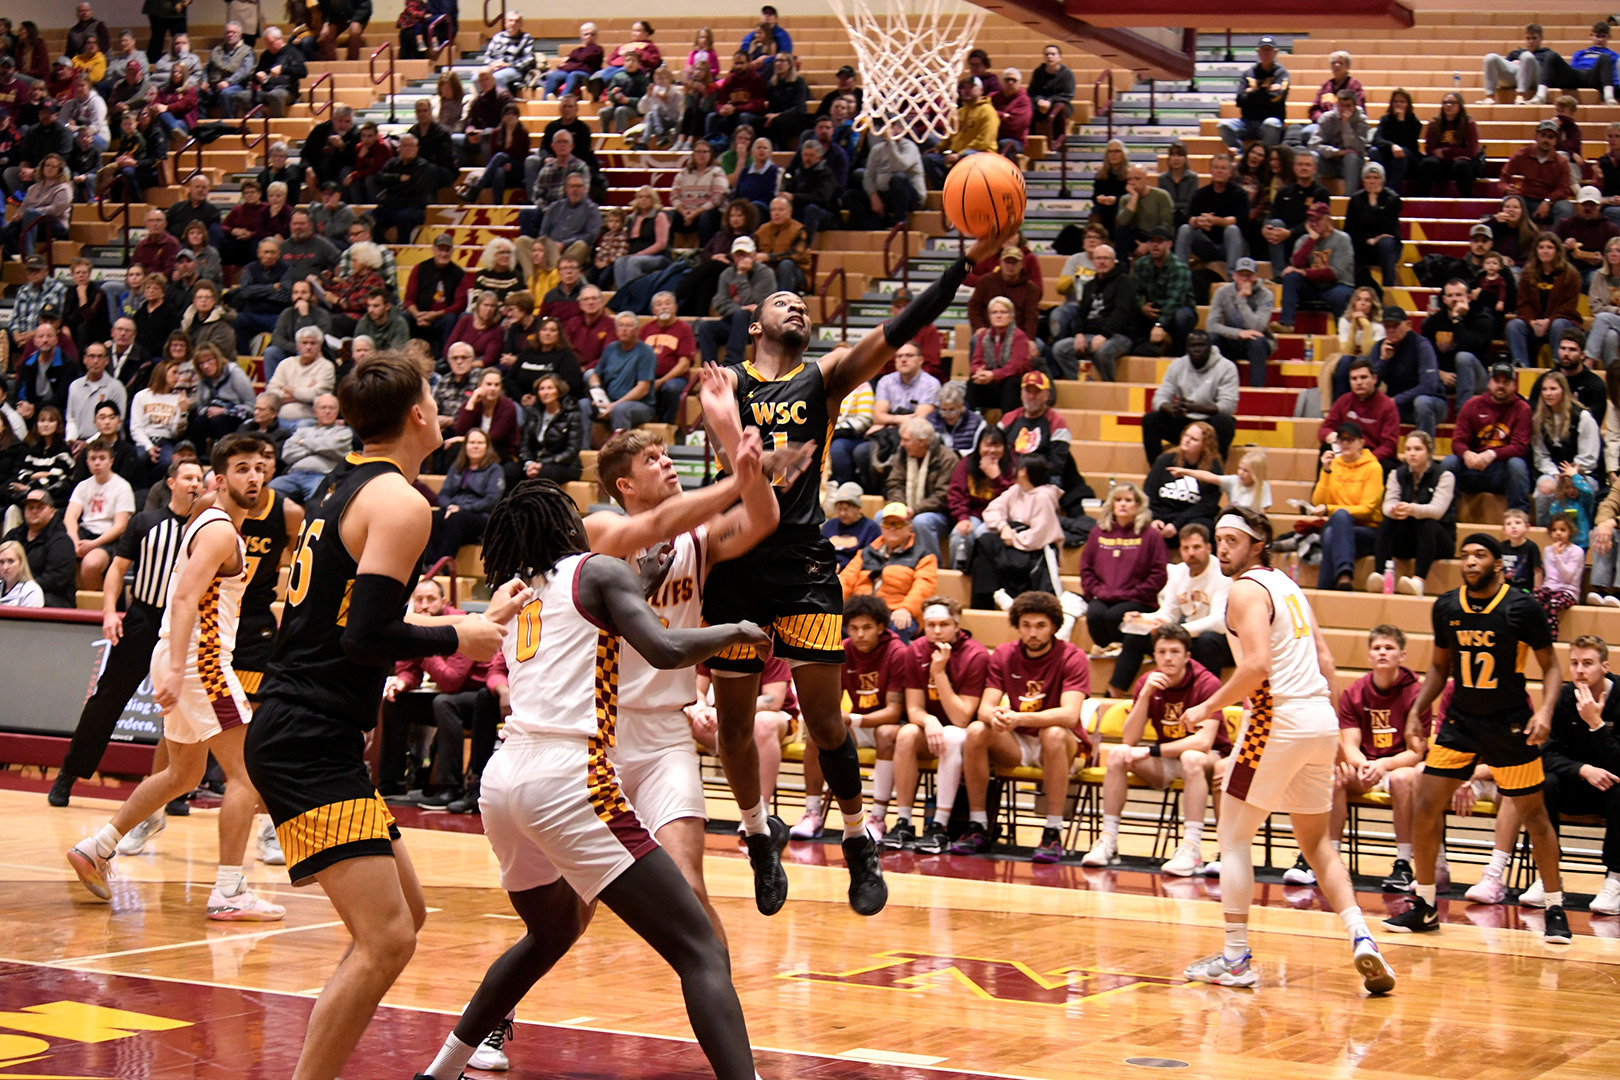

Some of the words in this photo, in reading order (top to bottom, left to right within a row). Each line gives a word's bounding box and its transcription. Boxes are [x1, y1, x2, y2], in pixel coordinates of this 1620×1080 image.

[750, 400, 808, 426] WSC
[515, 597, 544, 664] 0
[1456, 630, 1496, 648] WSC
[1459, 650, 1499, 690] 12
